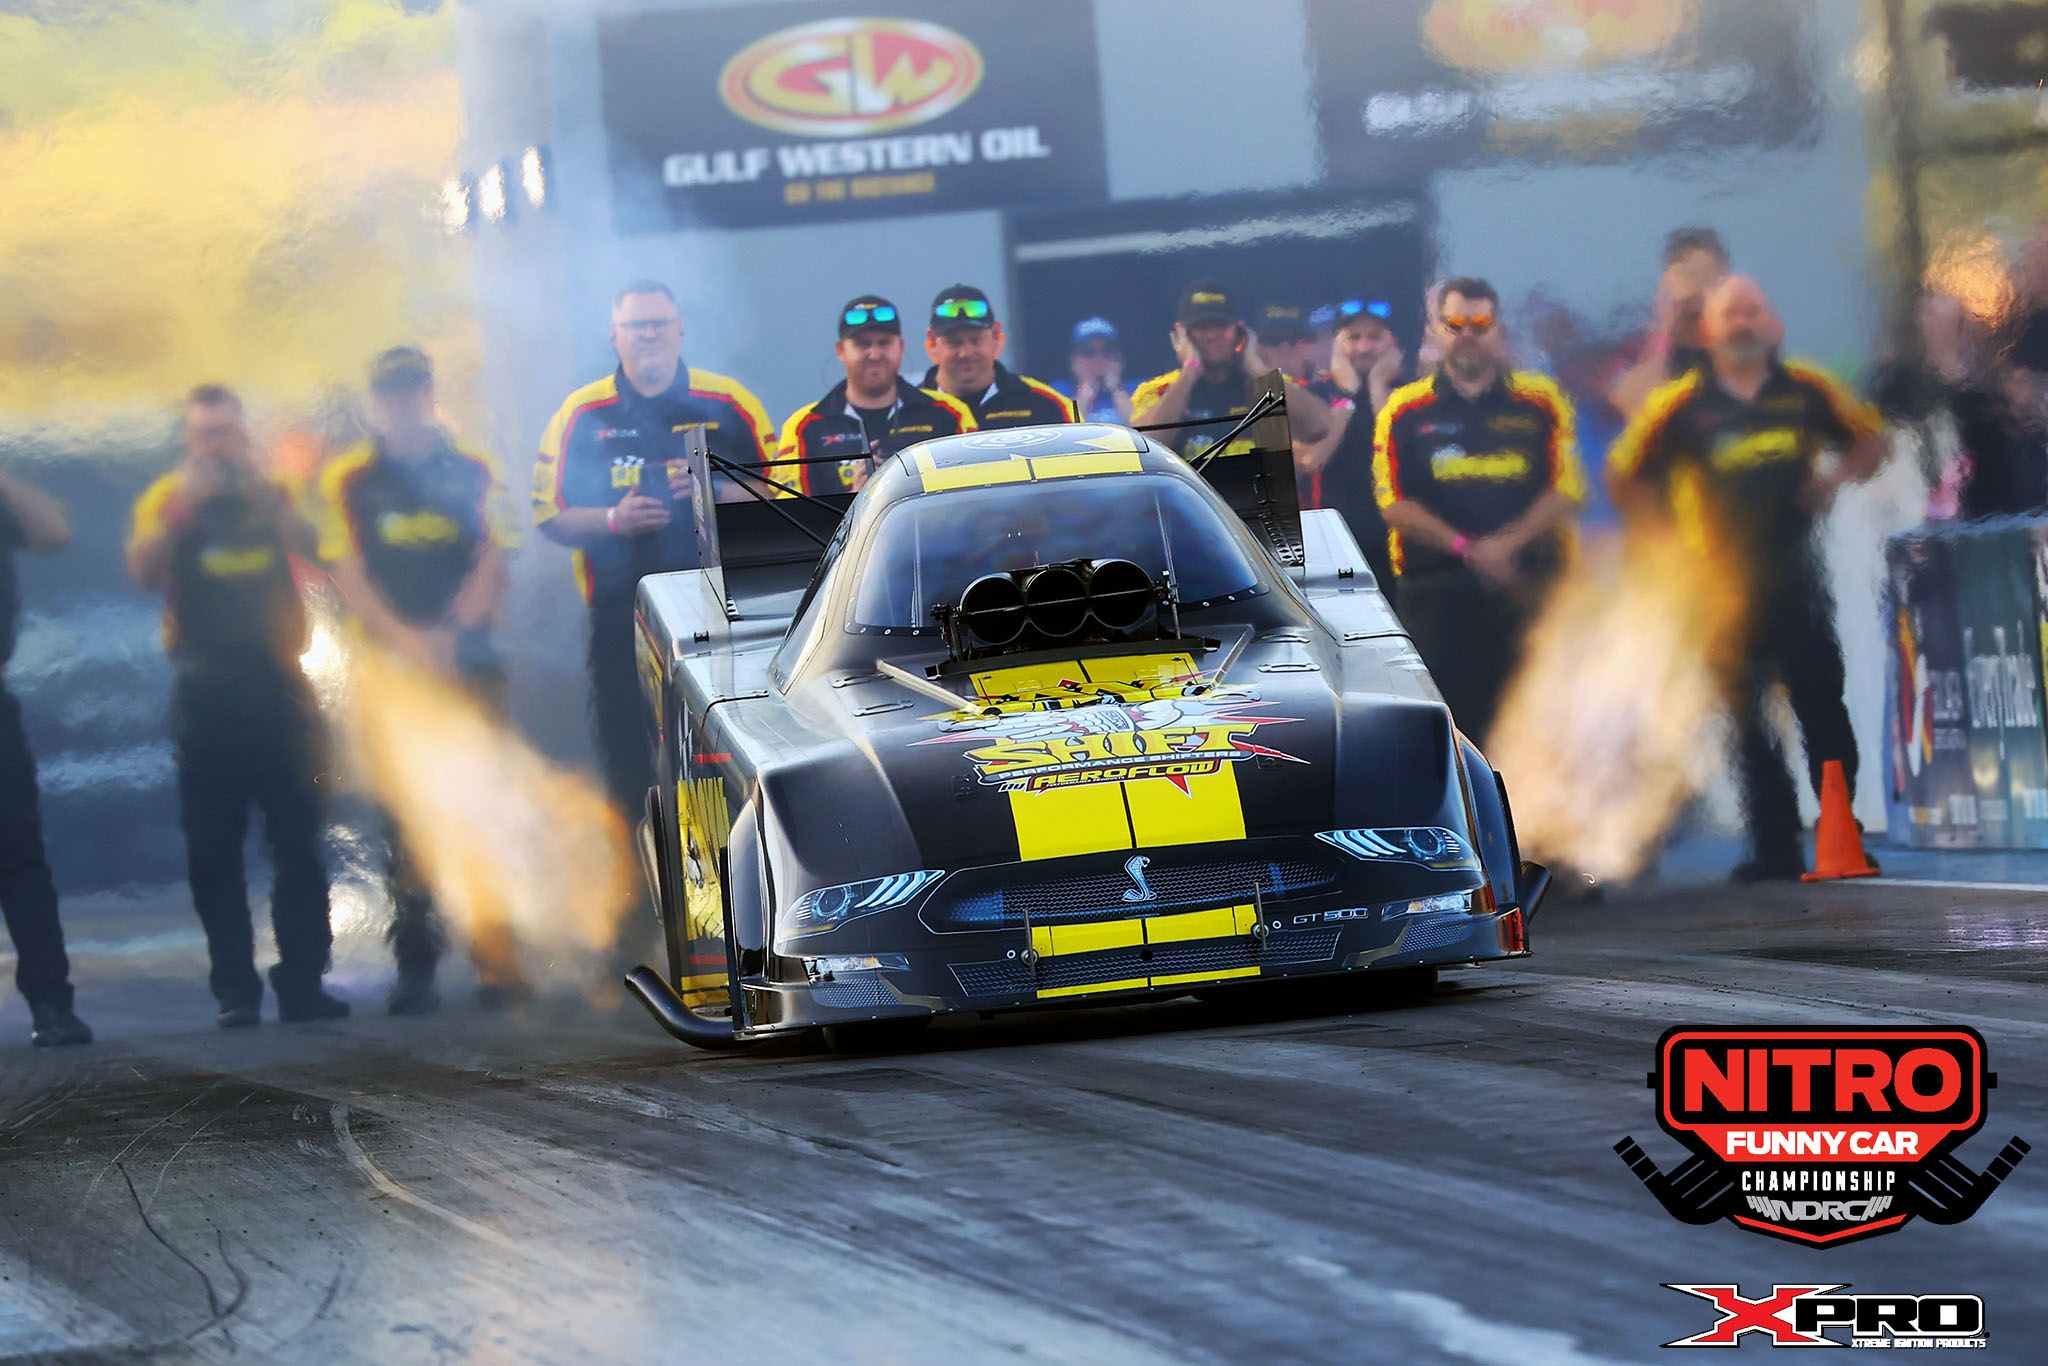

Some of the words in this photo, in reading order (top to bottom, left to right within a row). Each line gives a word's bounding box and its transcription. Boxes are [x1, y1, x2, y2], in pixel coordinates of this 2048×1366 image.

[663, 148, 769, 187] GULF
[777, 132, 973, 178] WESTERN
[980, 126, 1051, 162] OIL
[968, 723, 1257, 775] SHIFT
[999, 756, 1145, 780] PERFORMANCE
[1147, 750, 1241, 764] SHIFTERS
[1033, 760, 1214, 789] AEROFLOW
[1293, 913, 1322, 925] GT
[1324, 907, 1369, 921] 500
